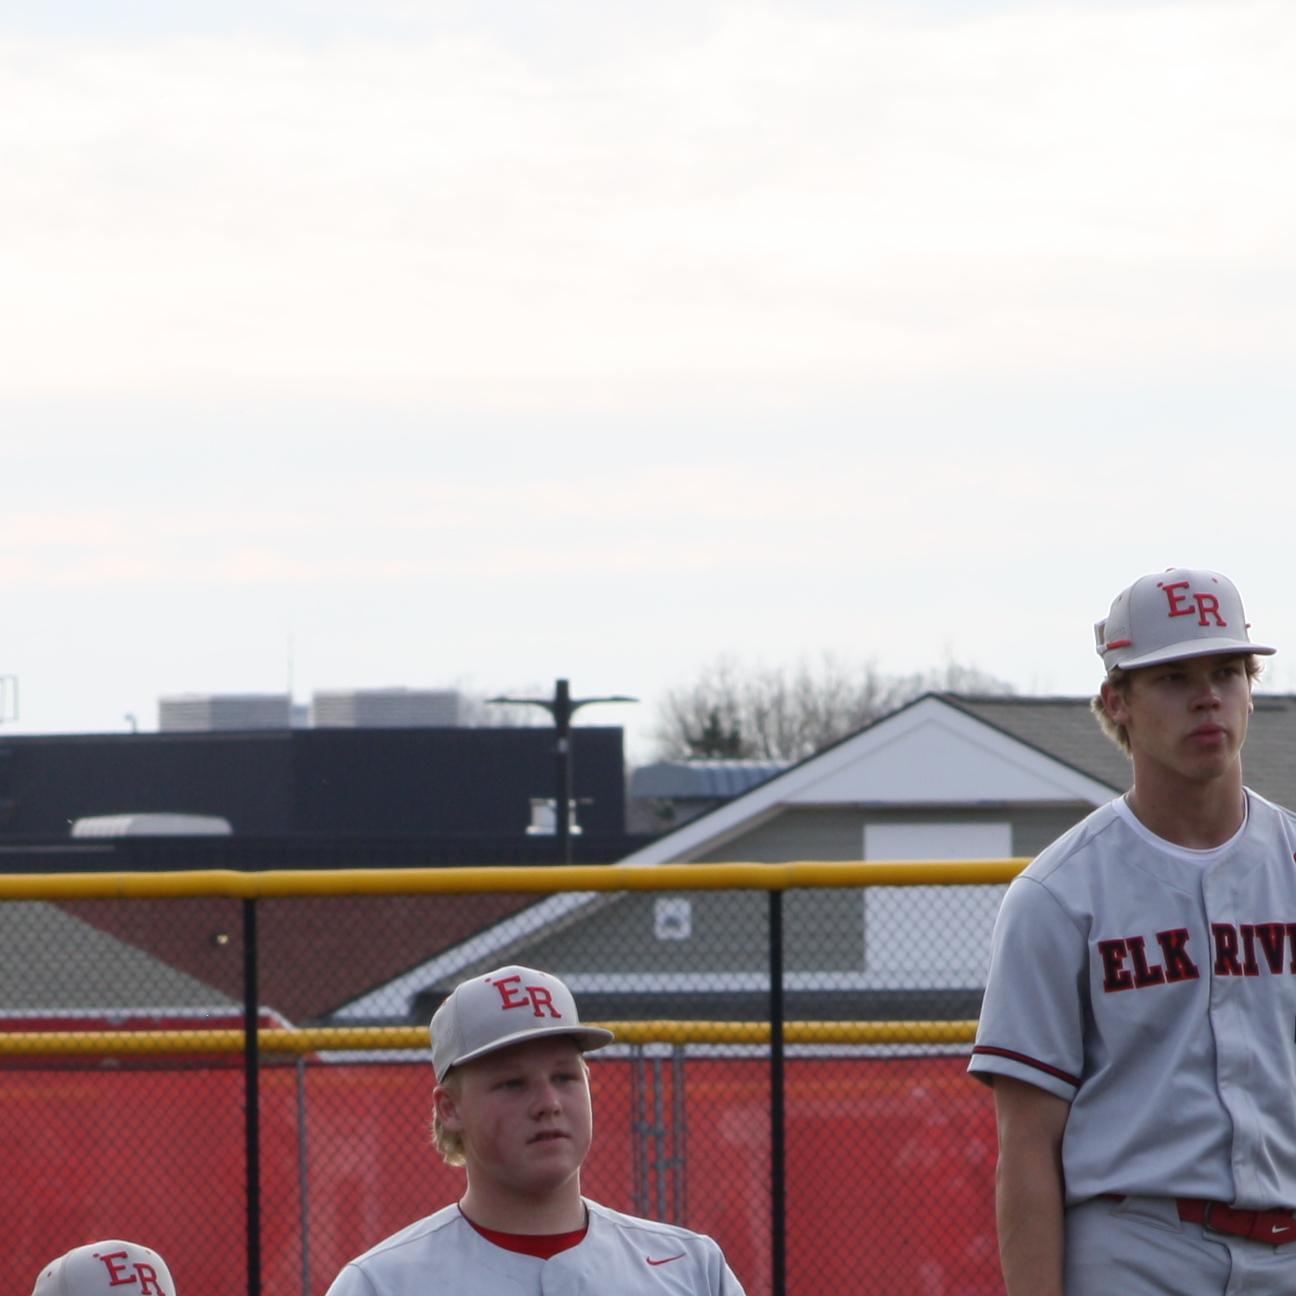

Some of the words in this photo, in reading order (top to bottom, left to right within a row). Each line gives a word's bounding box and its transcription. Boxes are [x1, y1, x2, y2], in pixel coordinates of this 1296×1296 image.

[1162, 581, 1227, 627] ER
[1098, 928, 1200, 993] ELK
[492, 975, 562, 1018] ER
